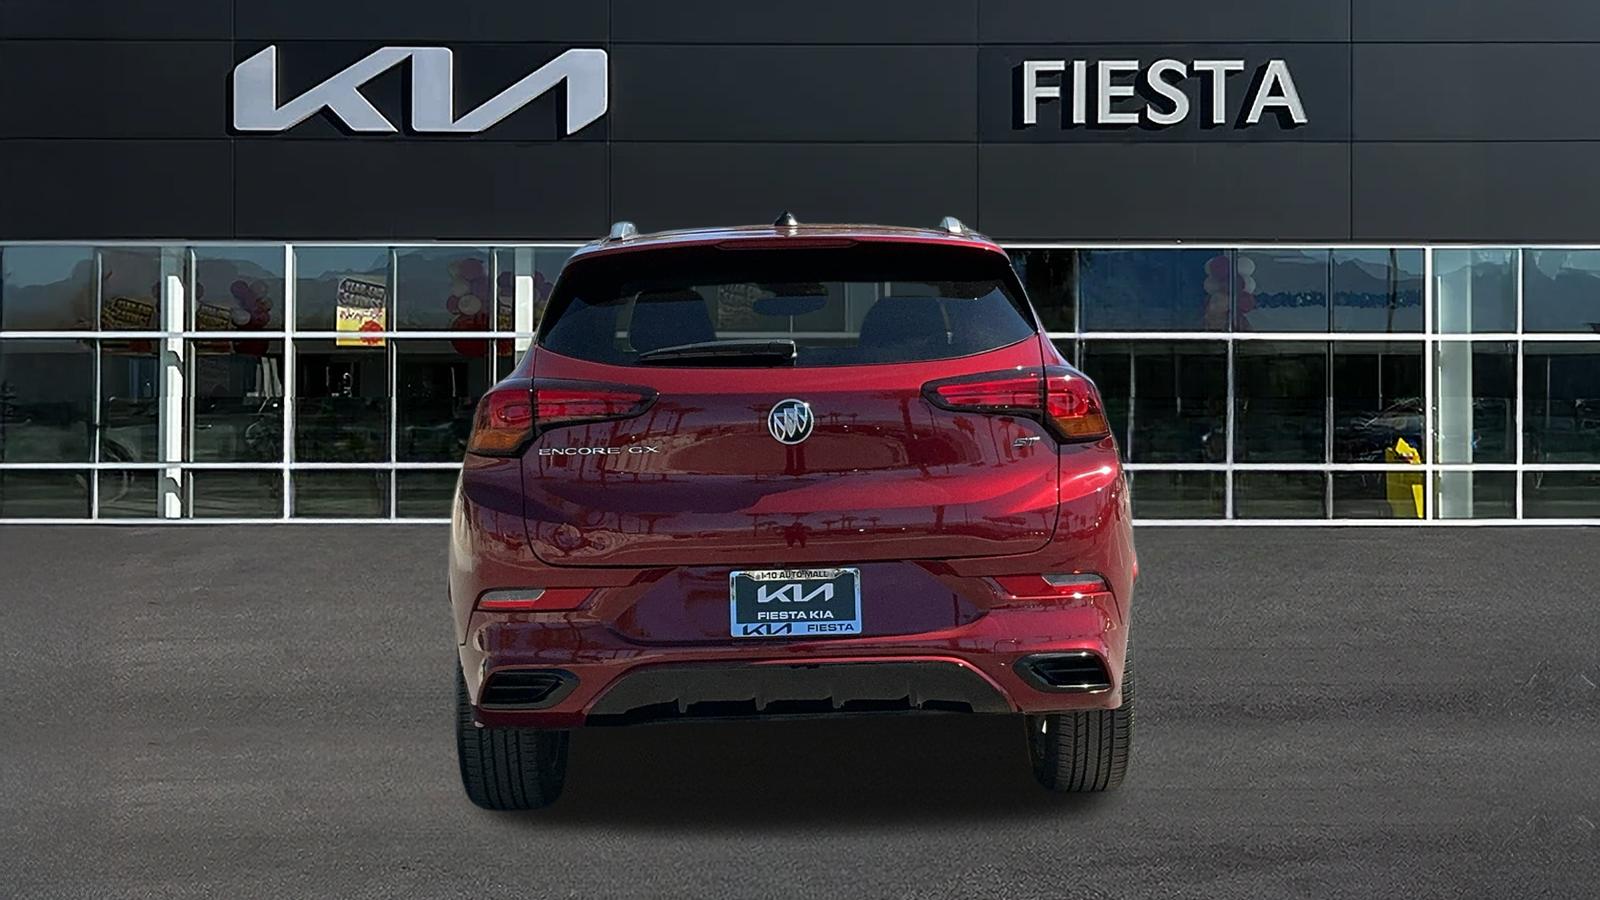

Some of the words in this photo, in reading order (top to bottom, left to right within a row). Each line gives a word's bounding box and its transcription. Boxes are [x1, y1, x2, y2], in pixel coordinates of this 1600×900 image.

[233, 44, 608, 135] KIA
[1023, 59, 1308, 124] FIESTA
[1013, 436, 1041, 447] ST
[538, 447, 621, 456] ENCORE
[628, 446, 659, 454] GX
[761, 572, 777, 580] I-10
[757, 582, 834, 603] KIA
[757, 611, 807, 620] FIESTA
[809, 610, 834, 619] KIA
[742, 623, 792, 635] KIA
[807, 623, 854, 632] FIESTA
